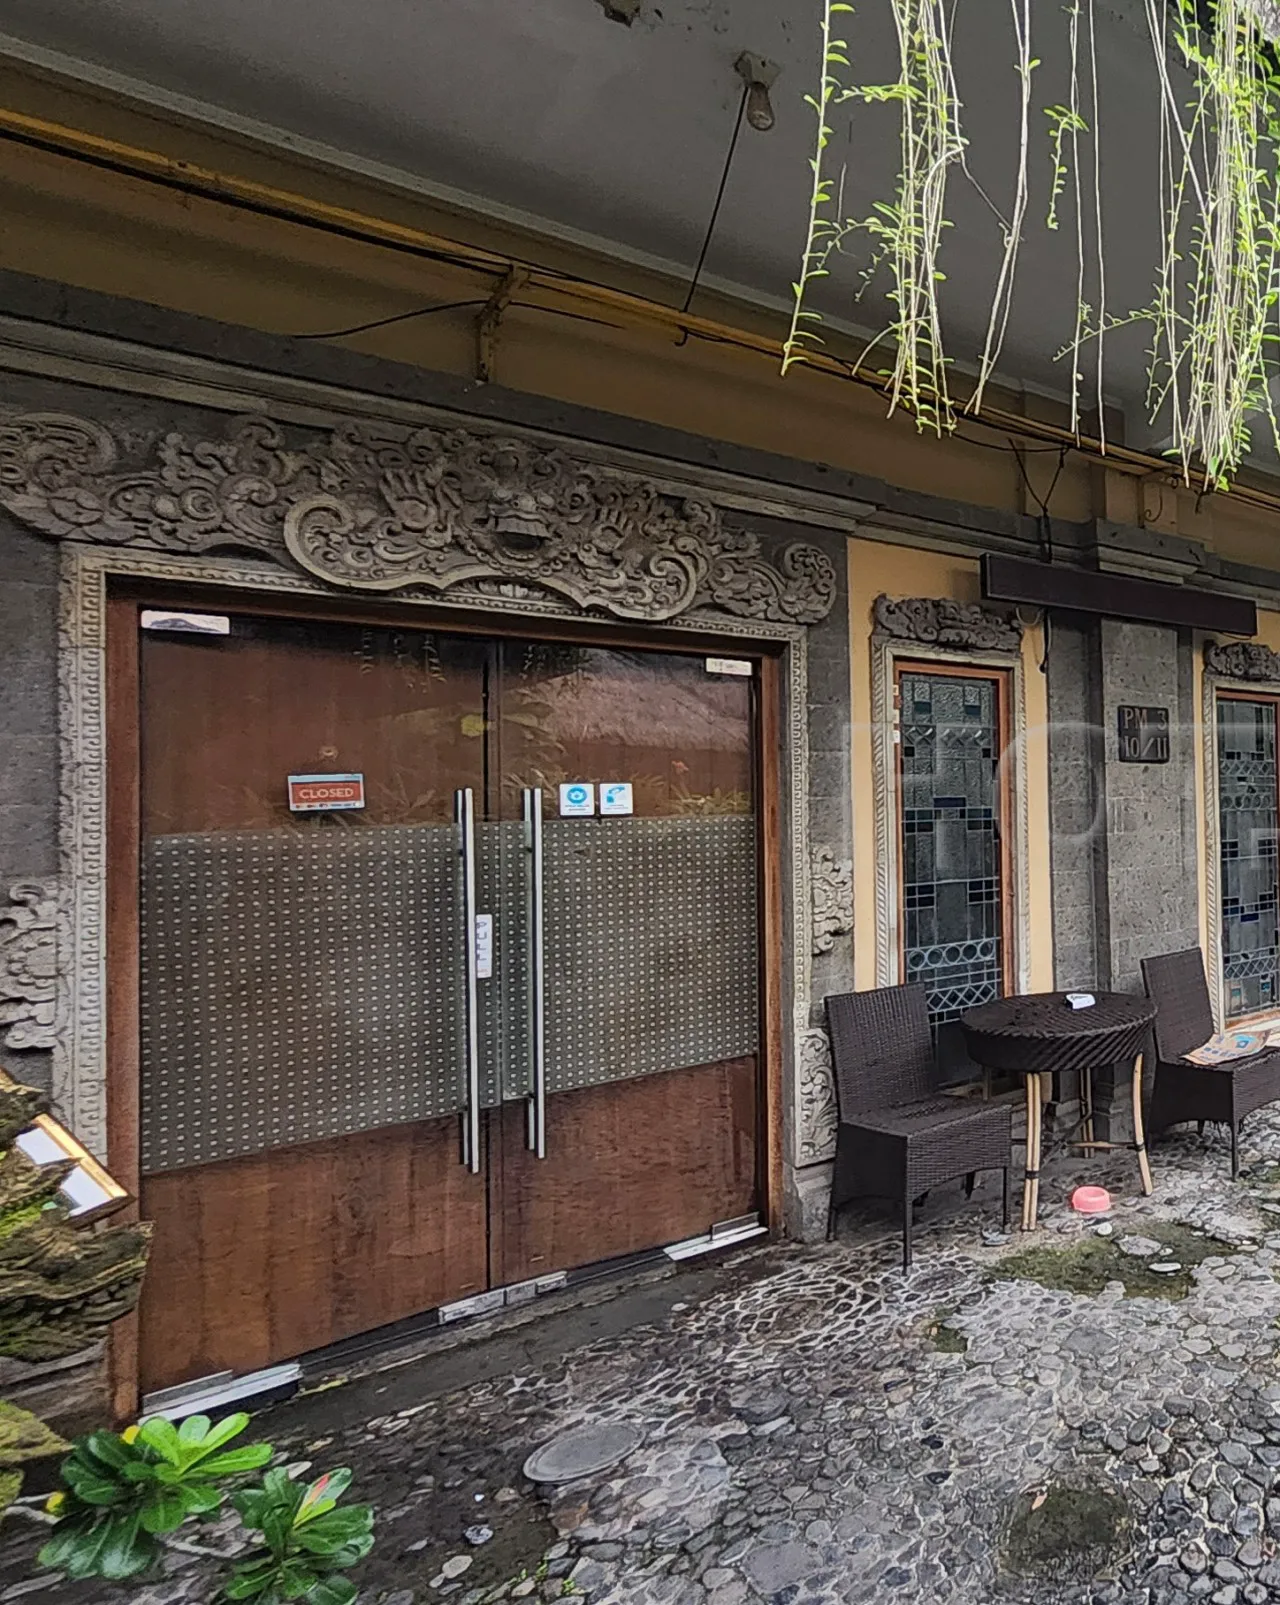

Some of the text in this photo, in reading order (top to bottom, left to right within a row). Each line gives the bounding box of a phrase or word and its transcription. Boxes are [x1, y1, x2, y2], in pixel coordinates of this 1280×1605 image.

[1123, 707, 1167, 731] PM 3
[1122, 735, 1168, 759] 10/11
[299, 787, 354, 799] CLOSED
